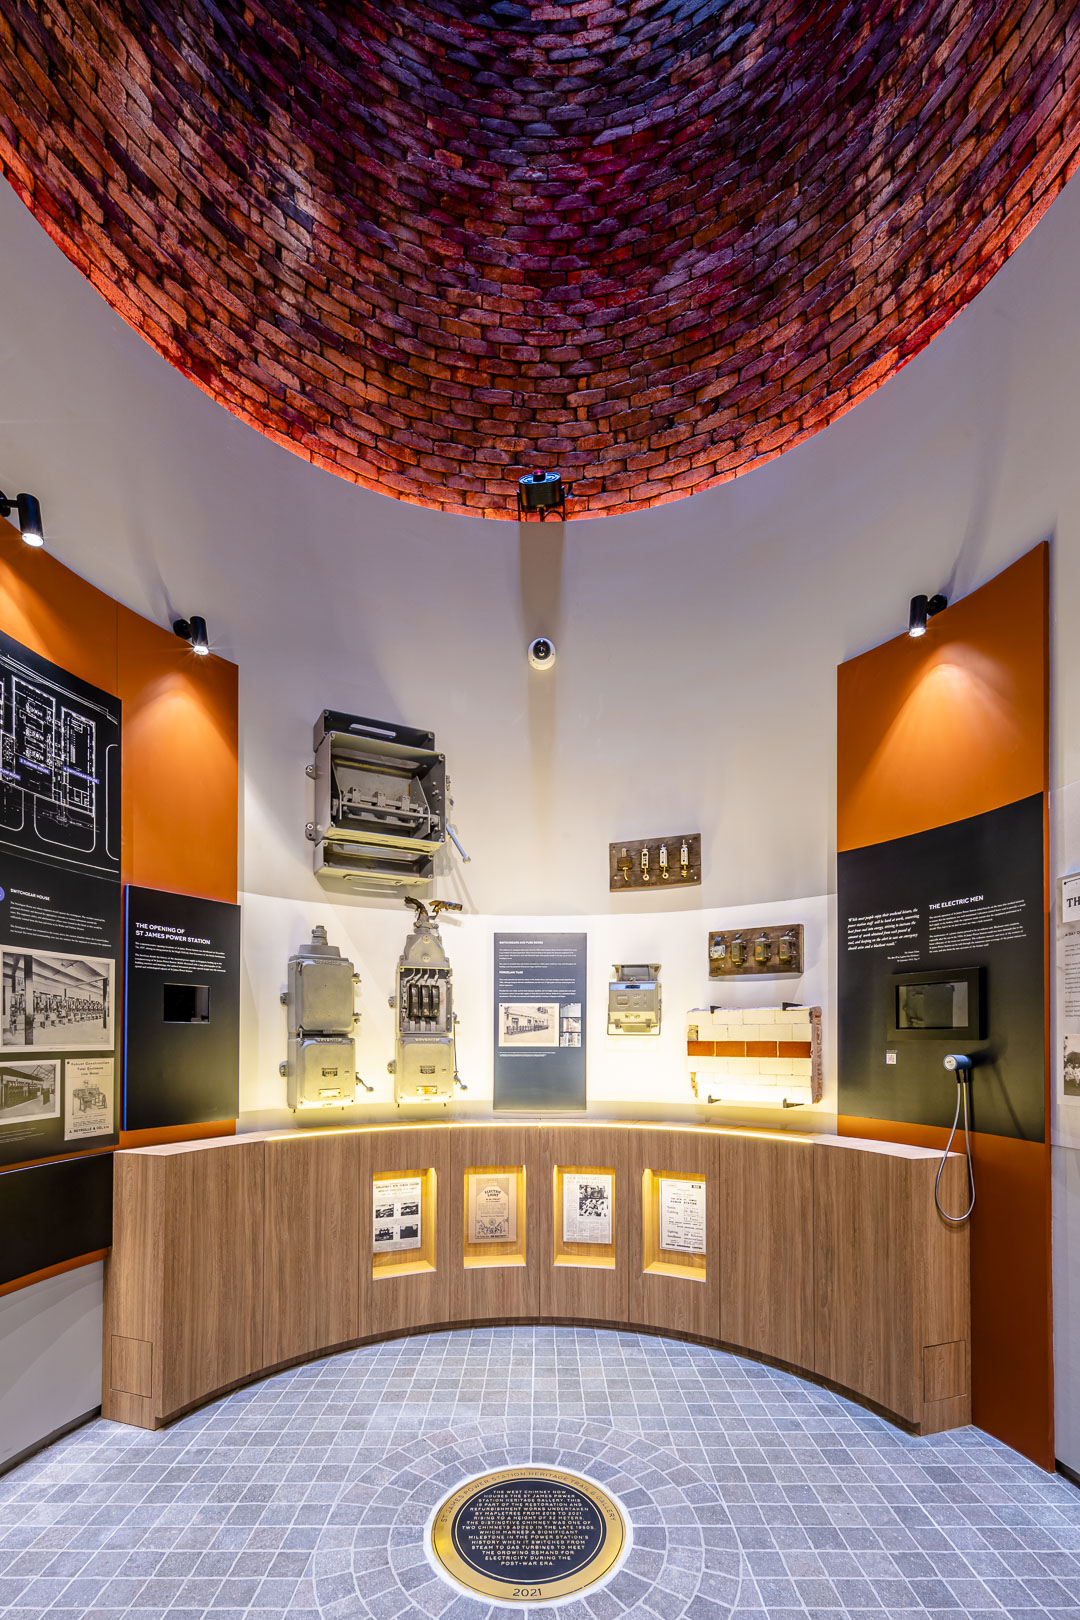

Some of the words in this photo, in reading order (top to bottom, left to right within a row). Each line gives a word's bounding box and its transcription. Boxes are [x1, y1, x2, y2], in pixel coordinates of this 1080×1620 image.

[10, 888, 36, 897] SWITCHGEAR
[941, 897, 969, 908] ELECTRIC
[970, 895, 984, 903] MEN
[149, 924, 176, 933] OPENING
[144, 931, 165, 939] JAMES
[165, 934, 187, 942] POWER
[187, 936, 210, 945] STATION
[441, 1515, 448, 1523] ST
[448, 1494, 464, 1513] JAMES
[464, 1480, 489, 1495] POWER
[491, 1471, 526, 1481] STATION
[528, 1471, 569, 1482] HERITAGE
[570, 1479, 589, 1492] TRAIL
[596, 1495, 616, 1521] GALLERY
[512, 1588, 542, 1597] 2021
